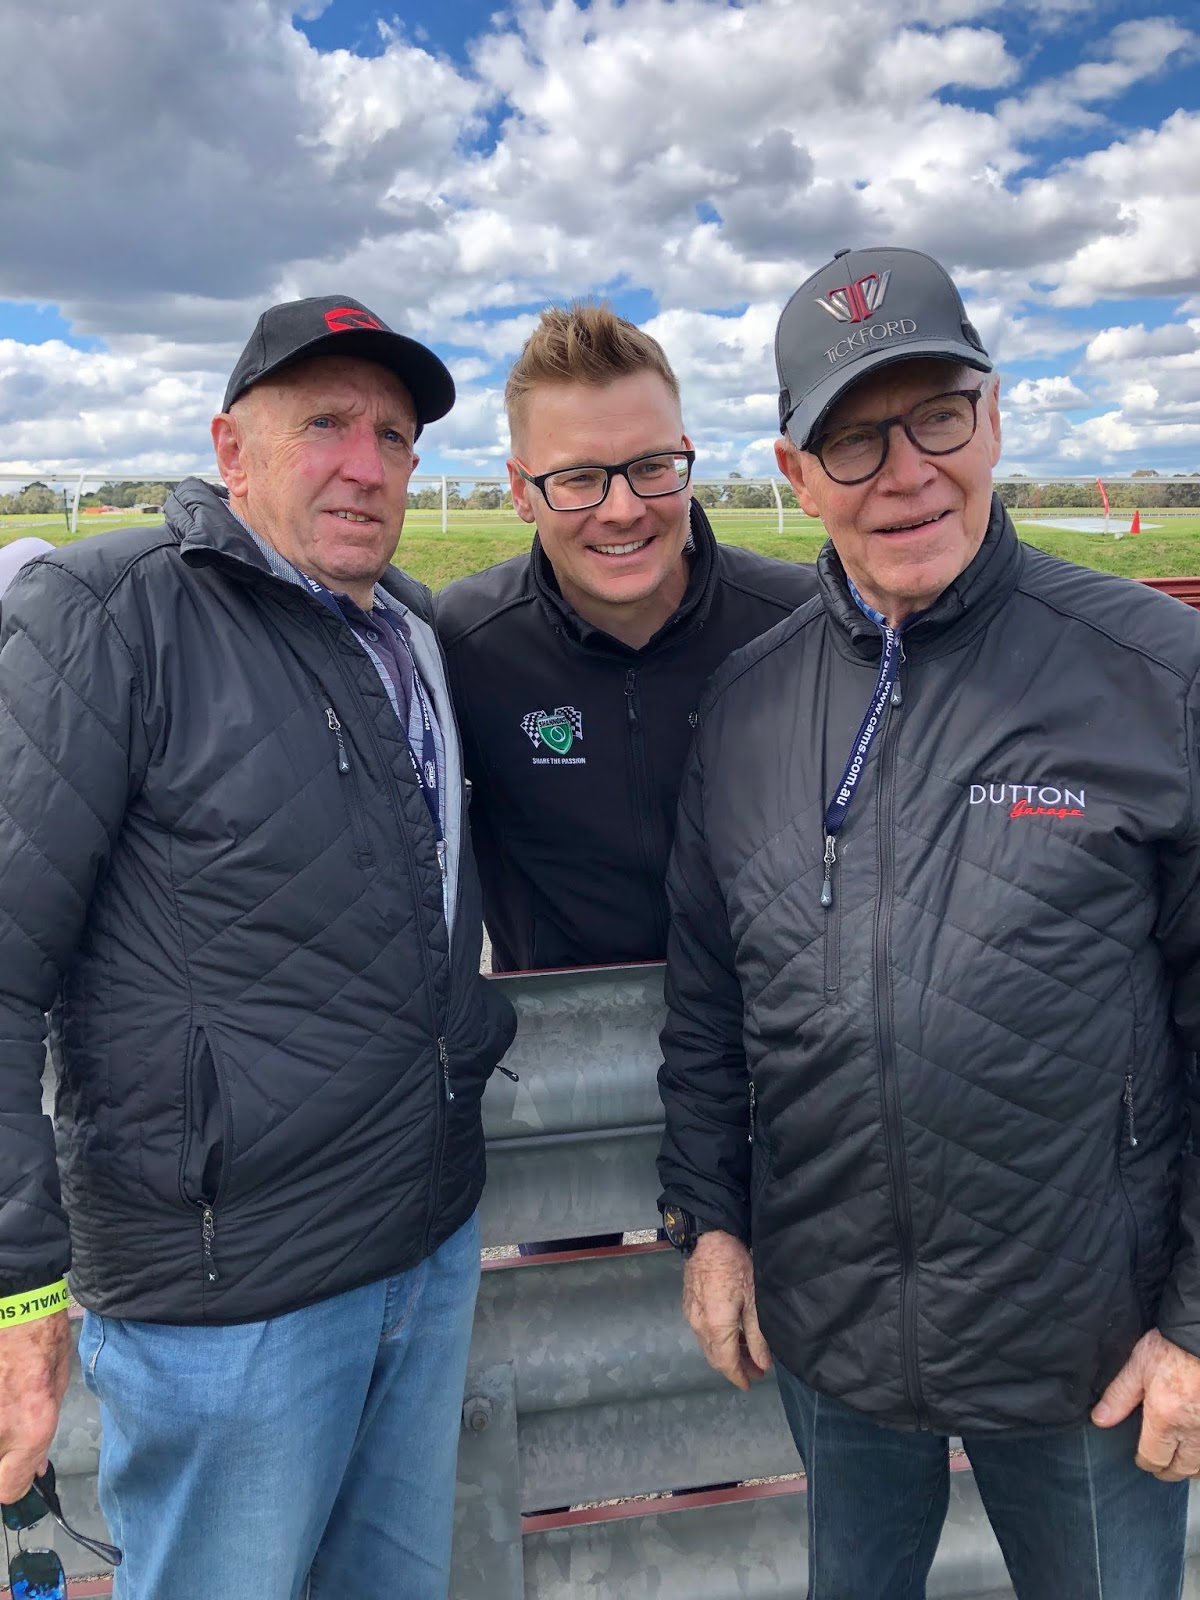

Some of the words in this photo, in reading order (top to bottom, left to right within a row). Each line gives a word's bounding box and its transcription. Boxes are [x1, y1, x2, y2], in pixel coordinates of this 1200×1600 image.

[823, 318, 917, 364] TICKFORD
[836, 681, 892, 806] www.cams.com.au
[969, 784, 1085, 807] DUTTON
[1010, 800, 1085, 818] Garage
[20, 1292, 61, 1315] WALK
